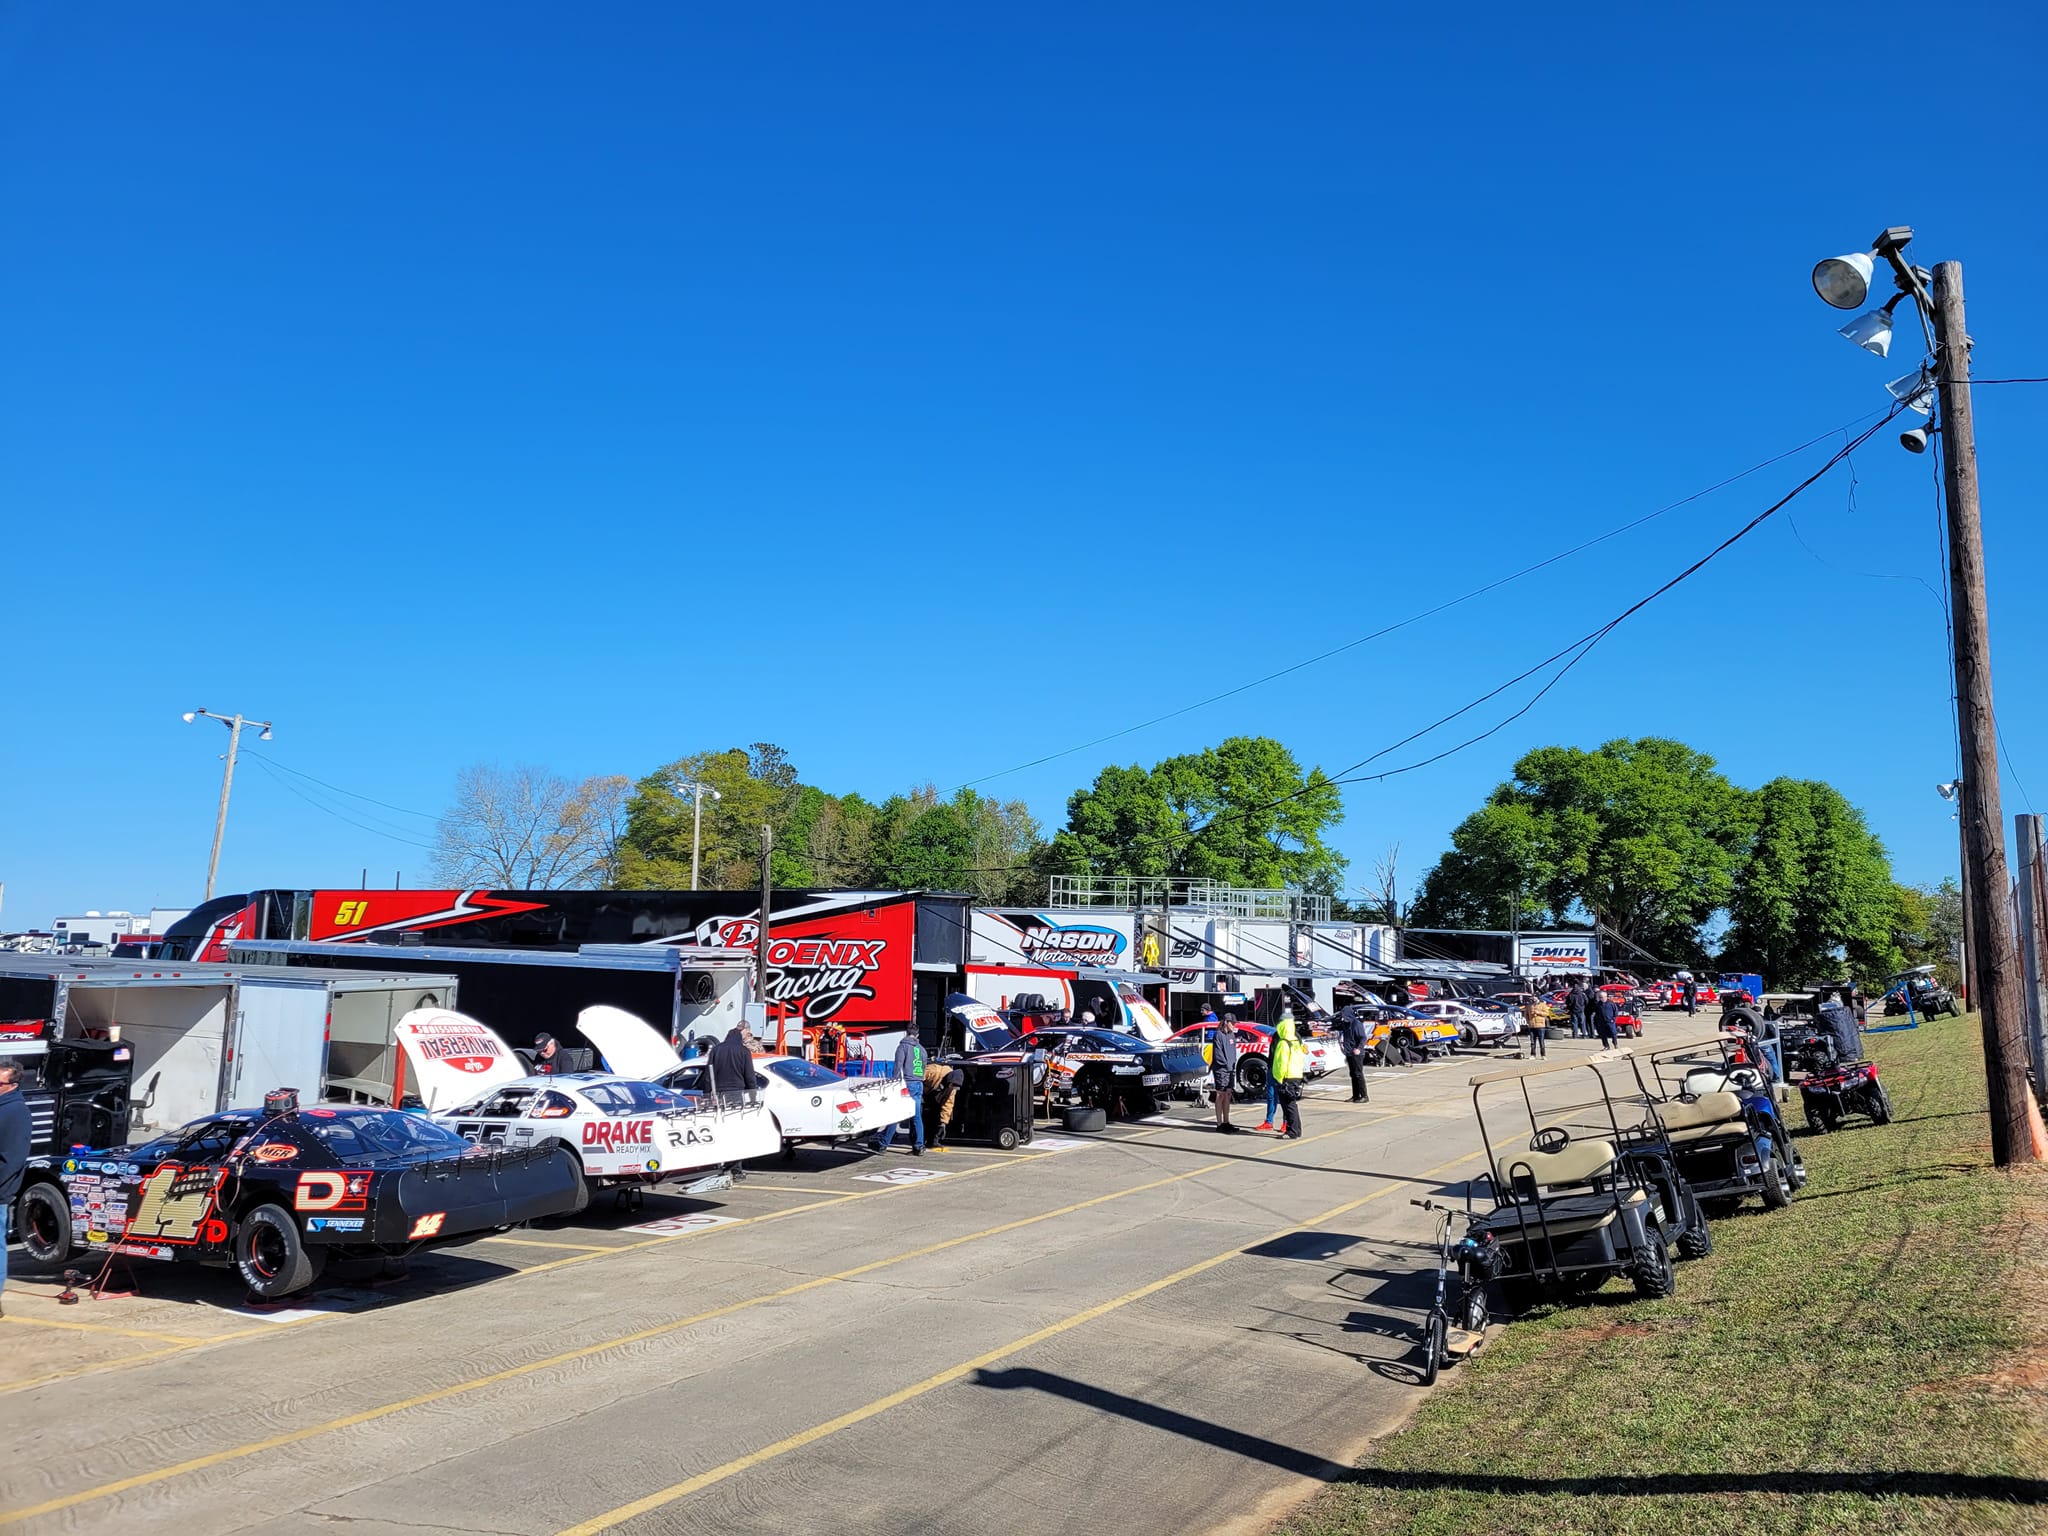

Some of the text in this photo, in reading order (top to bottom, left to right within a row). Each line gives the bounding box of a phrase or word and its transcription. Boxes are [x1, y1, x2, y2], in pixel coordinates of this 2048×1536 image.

[334, 901, 368, 926] 51
[719, 919, 885, 970] POENIX
[1021, 927, 1117, 951] NASON
[1031, 949, 1117, 966] Motorsports
[1532, 947, 1586, 956] SMITH
[419, 1036, 503, 1059] UNIVERSAL
[455, 1121, 510, 1146] 55
[582, 1120, 653, 1153] DRAKE
[260, 1147, 291, 1158] MGR
[616, 1145, 651, 1154] READY MIX
[206, 1219, 228, 1242] D
[408, 1212, 446, 1240] 14
